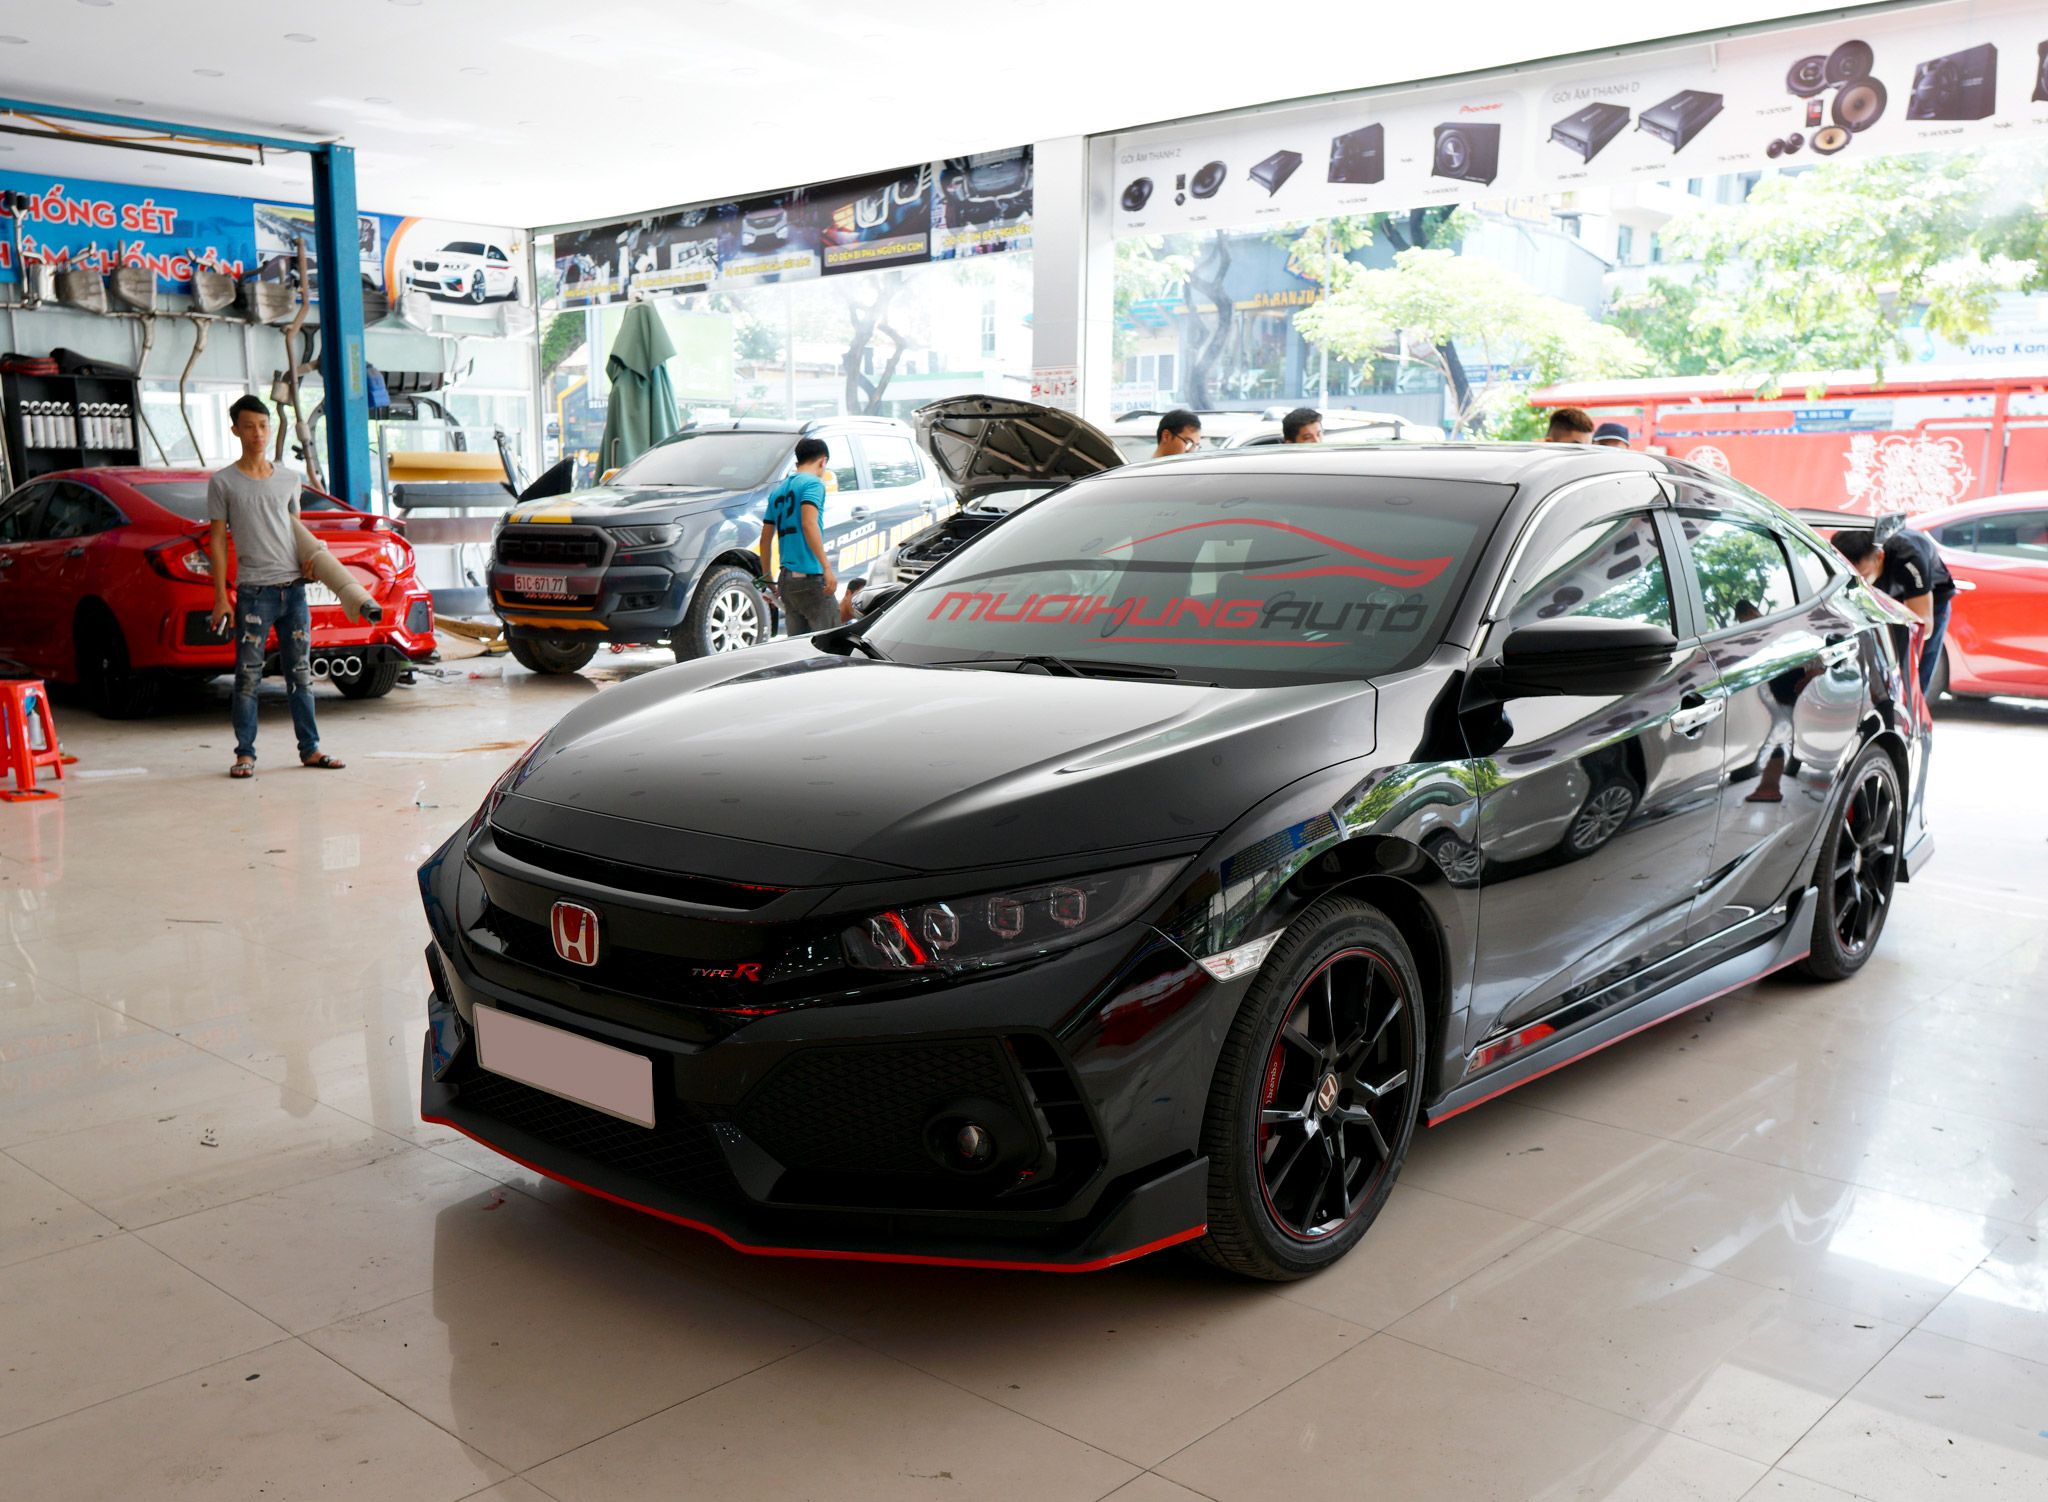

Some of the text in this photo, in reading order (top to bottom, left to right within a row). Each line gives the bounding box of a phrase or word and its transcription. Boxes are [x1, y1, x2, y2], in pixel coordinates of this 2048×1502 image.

[1592, 82, 1629, 97] THANH
[122, 199, 178, 235] SÉT
[1969, 342, 2048, 356] Viva Kan
[691, 962, 762, 982] TYPE R
